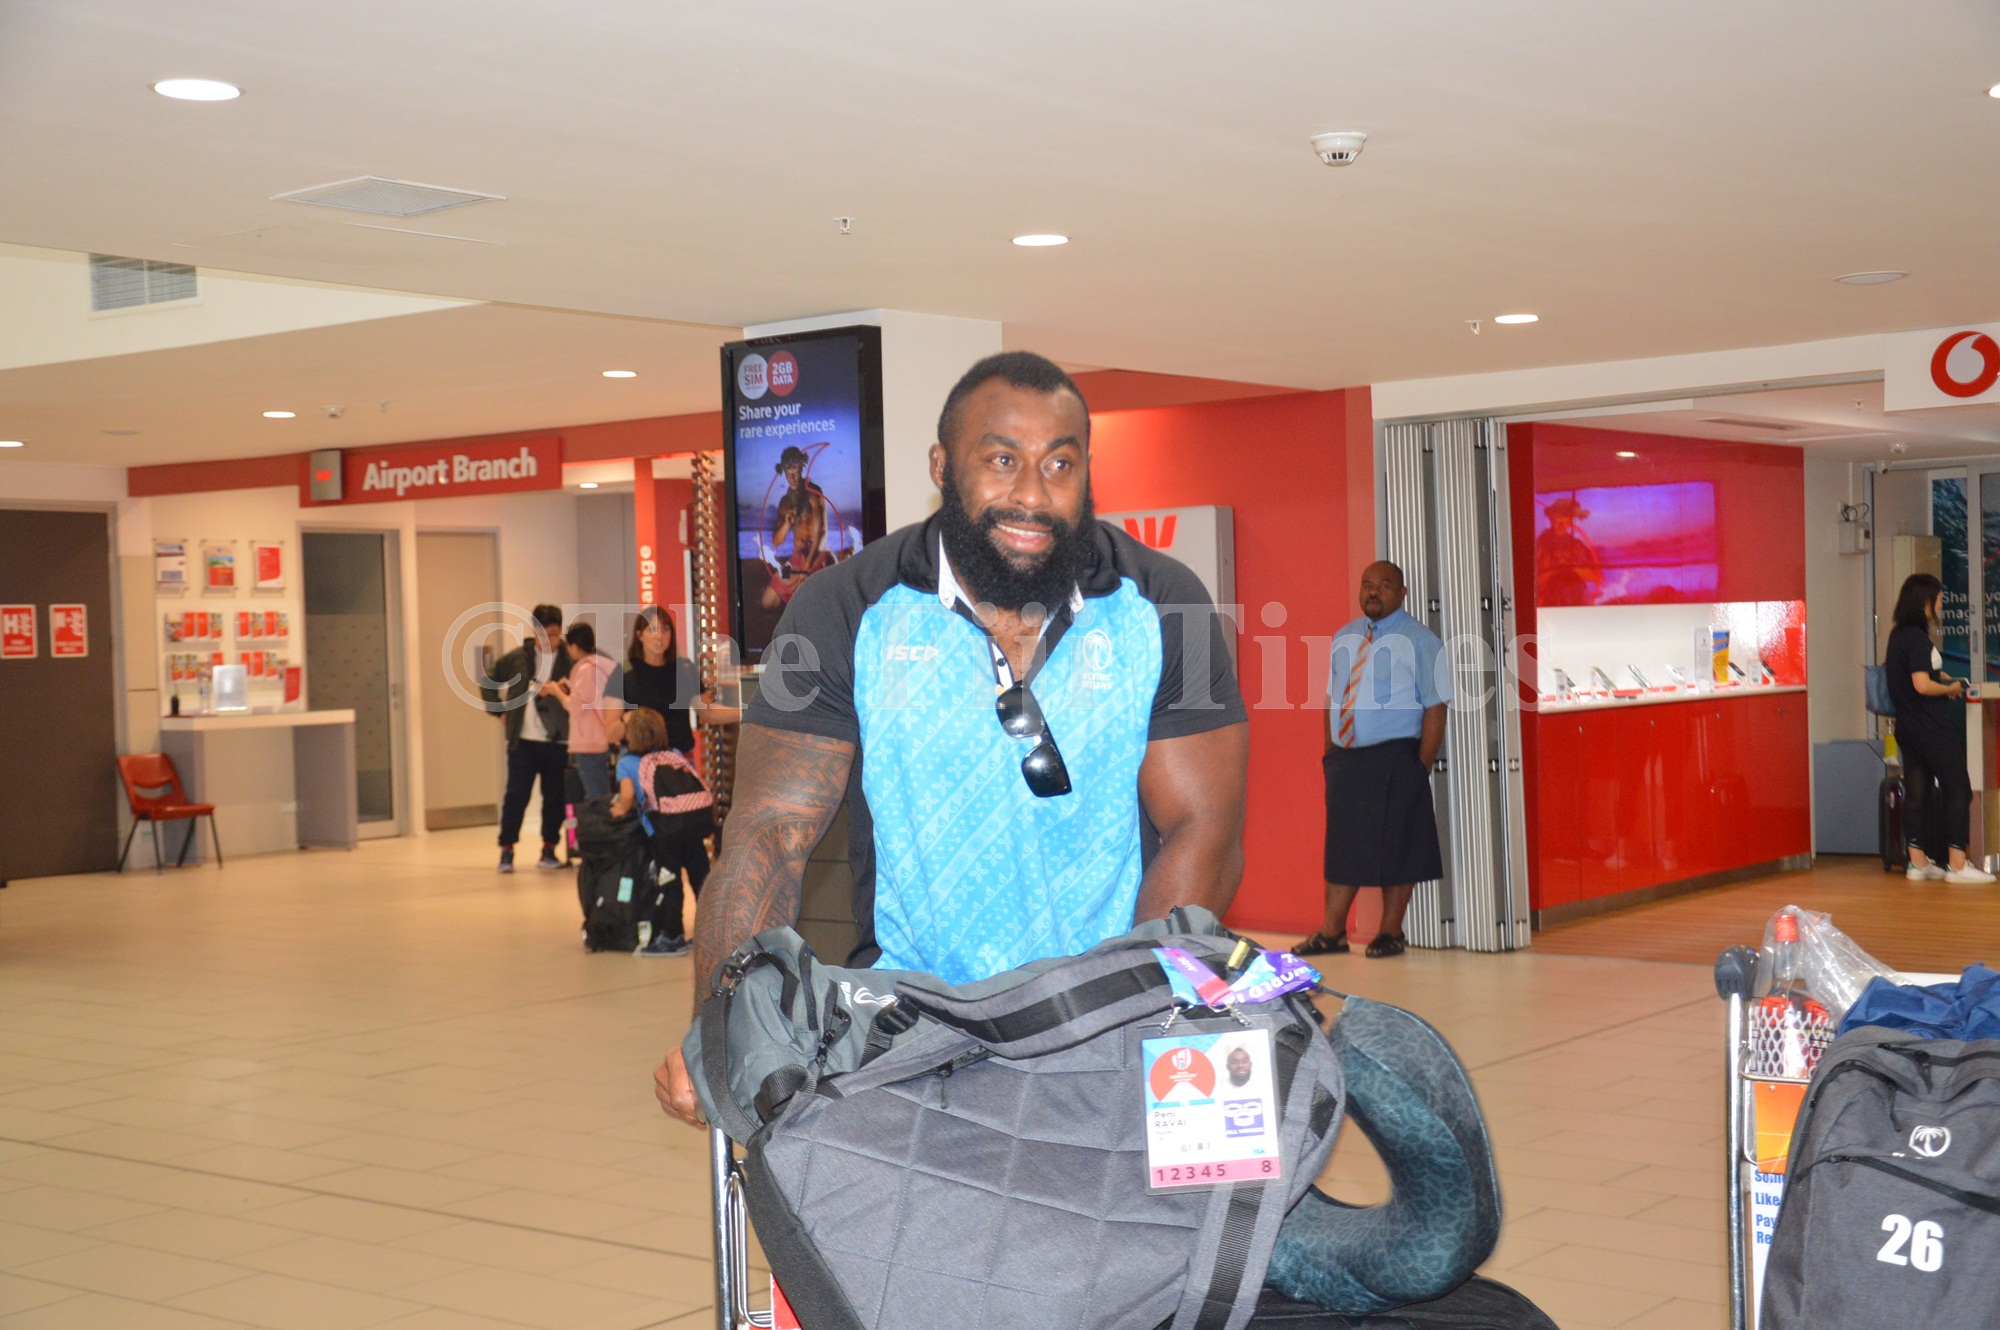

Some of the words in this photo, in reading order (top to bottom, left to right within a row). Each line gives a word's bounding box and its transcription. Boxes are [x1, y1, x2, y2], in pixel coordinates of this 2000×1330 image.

[744, 363, 763, 373] FREE
[772, 361, 793, 374] 2GB
[744, 374, 764, 386] SIM
[773, 375, 794, 386] DATA
[739, 404, 772, 420] Share
[774, 403, 801, 421] your
[740, 426, 765, 439] rare
[765, 419, 835, 439] experiences
[362, 460, 449, 496] Airport
[453, 447, 537, 483] Branch
[640, 545, 657, 609] ange
[886, 645, 926, 661] ISC
[1154, 1110, 1176, 1119] Peni
[1155, 1119, 1187, 1128] RAVAI
[1755, 1192, 1781, 1207] Like
[1876, 1214, 1944, 1272] 26
